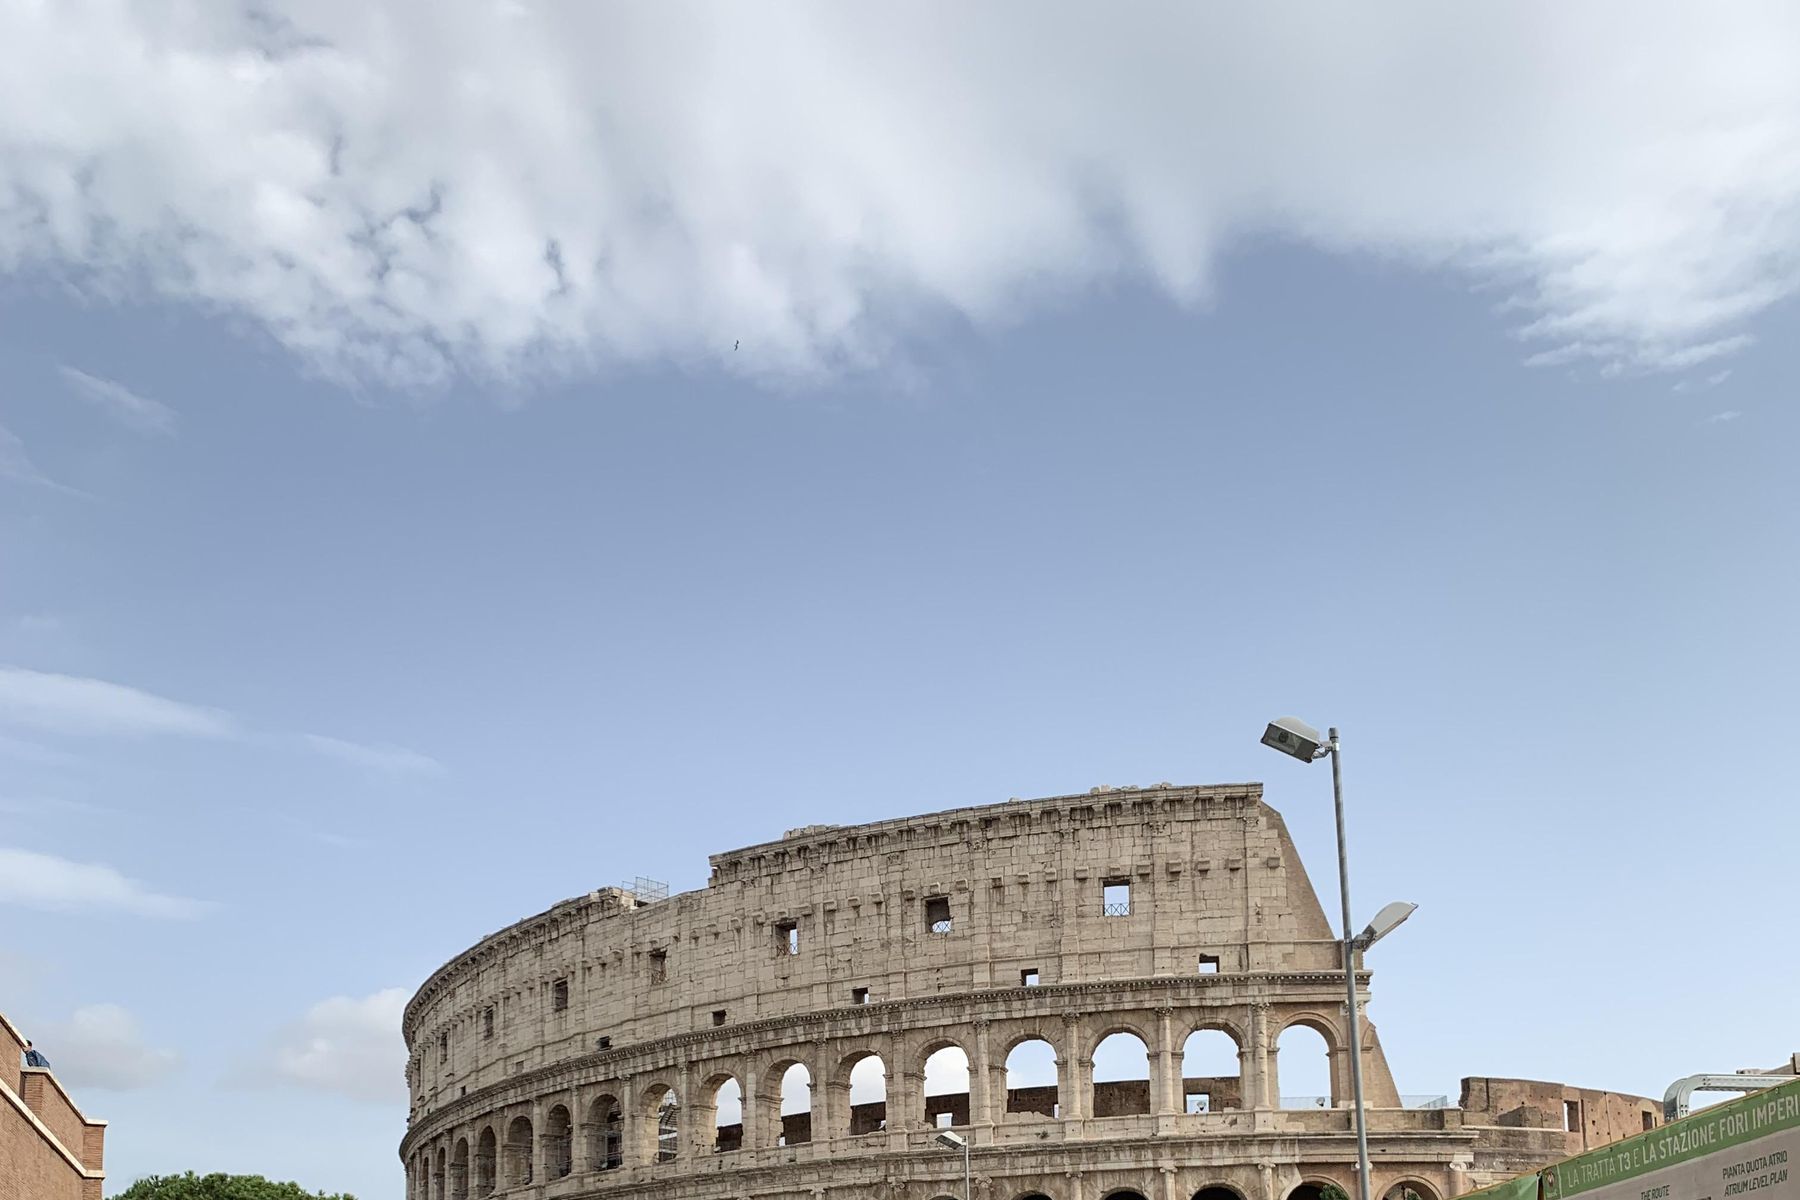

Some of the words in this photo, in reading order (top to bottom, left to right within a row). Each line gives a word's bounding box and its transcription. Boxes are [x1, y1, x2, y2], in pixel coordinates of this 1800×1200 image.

[1568, 1169, 1579, 1188] LA
[1581, 1157, 1616, 1183] TRATTA
[1617, 1152, 1631, 1172] T3
[1633, 1148, 1641, 1168] E
[1643, 1143, 1657, 1165] LA
[1659, 1122, 1716, 1159] STAZIONE
[1720, 1111, 1749, 1139] FORI
[1752, 1094, 1799, 1130] IMPERI
[1722, 1163, 1746, 1179] PIANTA
[1746, 1157, 1767, 1173] QUOTA
[1768, 1150, 1788, 1167] ATRIO
[1651, 1185, 1671, 1200] ROUTE
[1724, 1179, 1748, 1197] ATRIUM
[1749, 1175, 1769, 1191] LEVEL
[1770, 1169, 1788, 1185] PLAN
